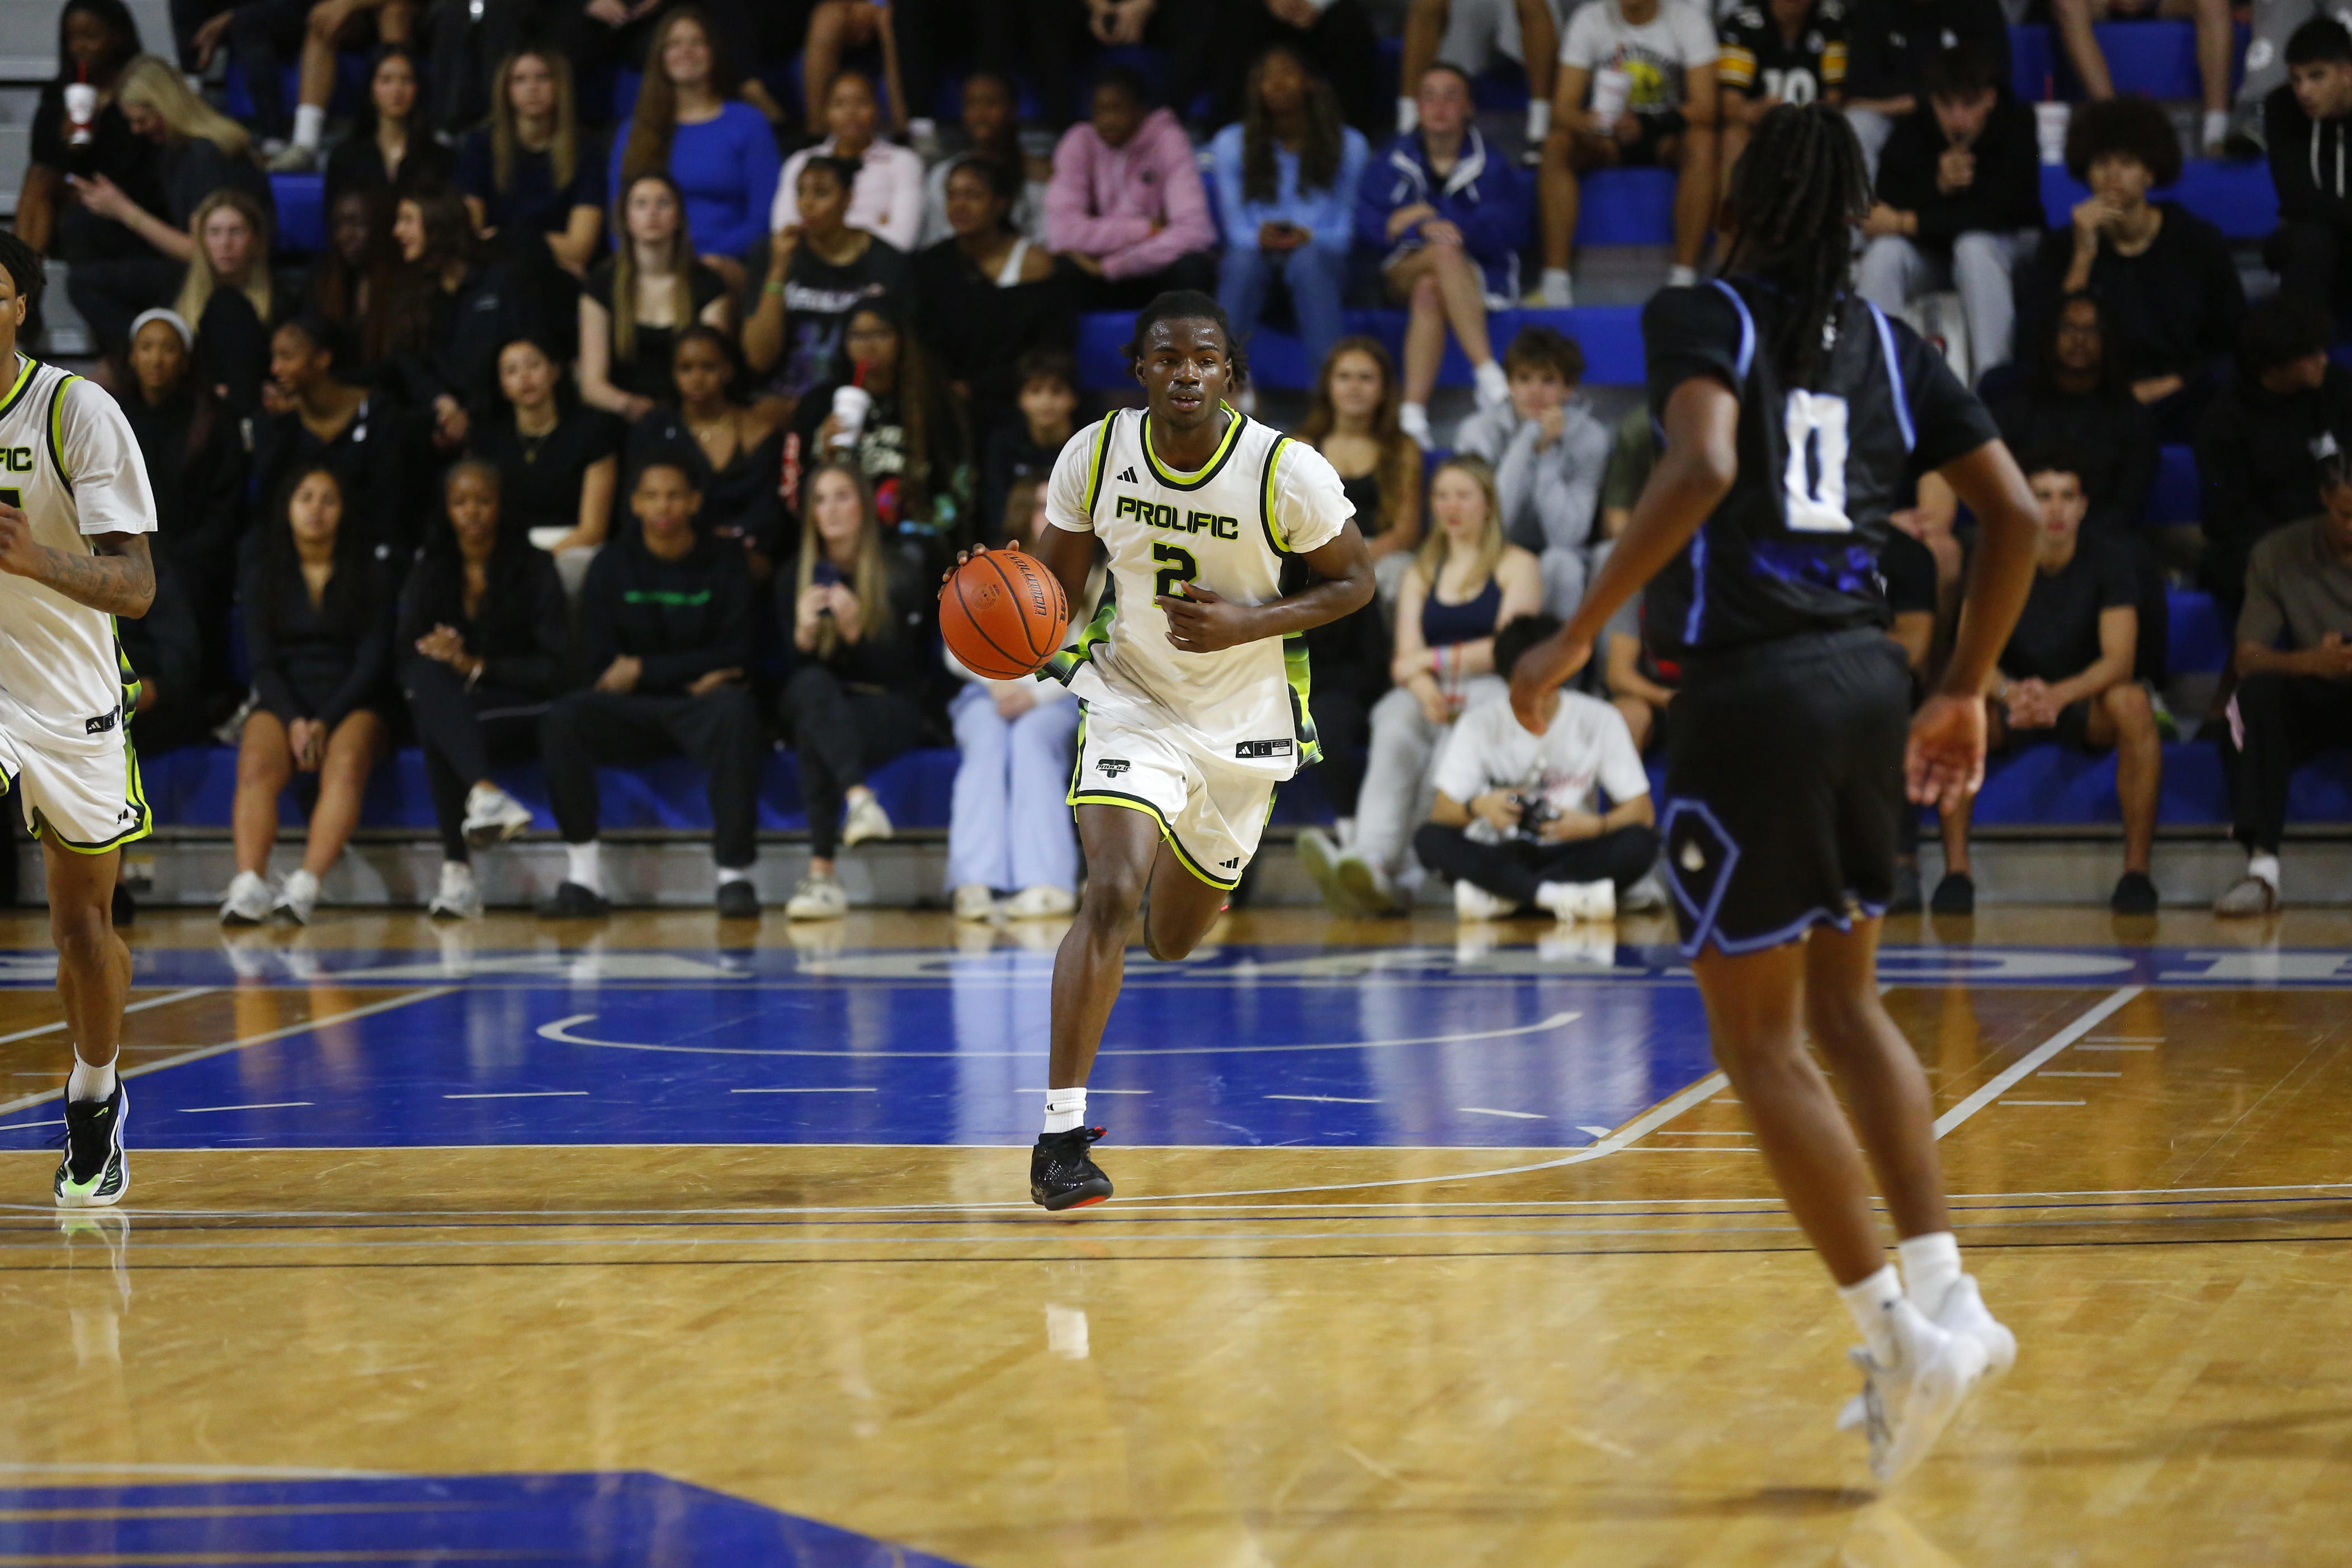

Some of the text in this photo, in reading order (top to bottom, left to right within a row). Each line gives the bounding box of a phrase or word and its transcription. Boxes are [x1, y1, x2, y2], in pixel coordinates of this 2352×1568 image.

[1784, 388, 1853, 532] 0
[1116, 494, 1239, 541] PROLIFIC
[1152, 540, 1199, 608] 2
